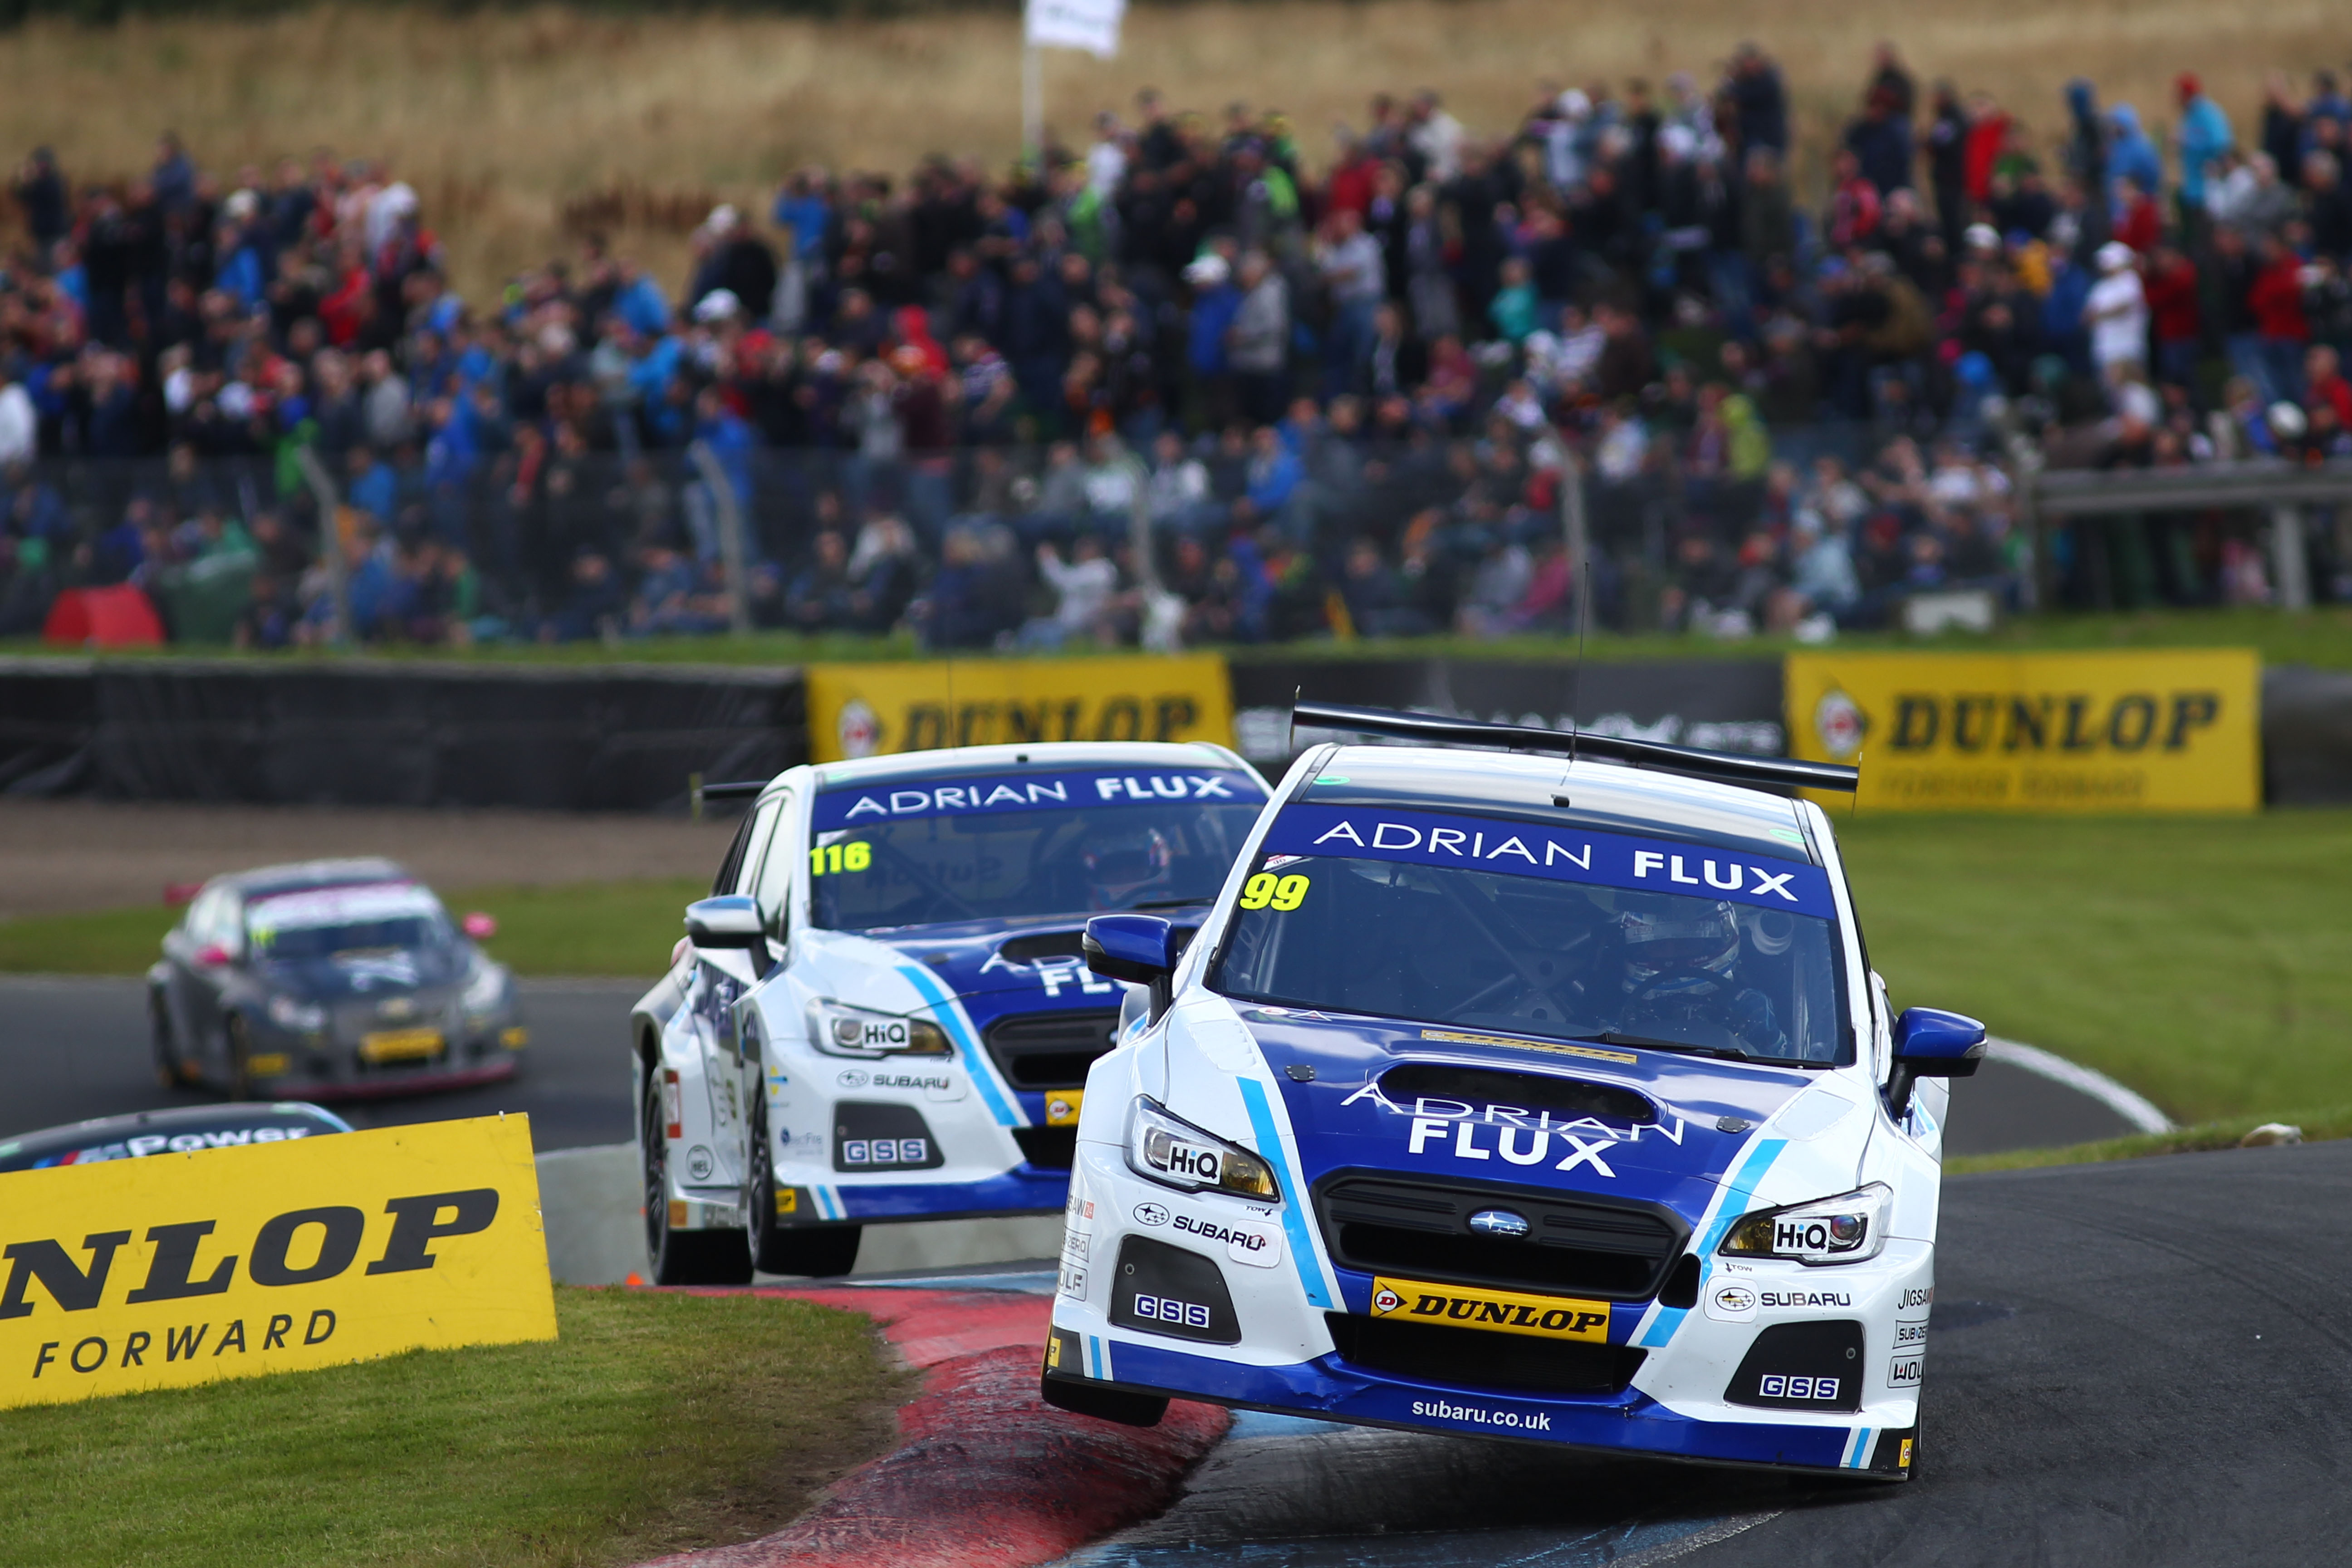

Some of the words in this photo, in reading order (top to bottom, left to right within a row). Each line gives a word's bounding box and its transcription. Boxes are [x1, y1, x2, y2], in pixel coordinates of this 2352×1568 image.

[900, 692, 1198, 750] DUNLOP
[1886, 691, 2220, 754] DUNLOP
[845, 781, 1068, 819] ADRIAN
[1095, 776, 1233, 800] FLUX
[810, 841, 871, 875] 116
[1313, 820, 1592, 871] ADRIAN
[1633, 850, 1799, 902] FLUX
[1240, 872, 1310, 911] 99
[1039, 967, 1132, 997] FL
[865, 1023, 906, 1044] HiQ
[872, 1074, 950, 1089] SUBARU
[1340, 1082, 1684, 1146] ADRIAN
[127, 1127, 311, 1157] Power
[848, 1142, 922, 1161] GSS
[1408, 1117, 1618, 1178] FLUX
[1170, 1147, 1219, 1180] HiQ
[1173, 1215, 1262, 1251] SUBARU
[1777, 1224, 1827, 1251] HiQ
[0, 1187, 500, 1320] NLOP
[1730, 1264, 1753, 1272] TOW
[1137, 1296, 1206, 1326] GSS
[1410, 1294, 1607, 1333] DUNLOP
[1761, 1292, 1851, 1306] SUBARU
[32, 1308, 337, 1379] FORWARD
[1763, 1377, 1836, 1398] GSS
[1411, 1400, 1551, 1431] subaru.co.uk
